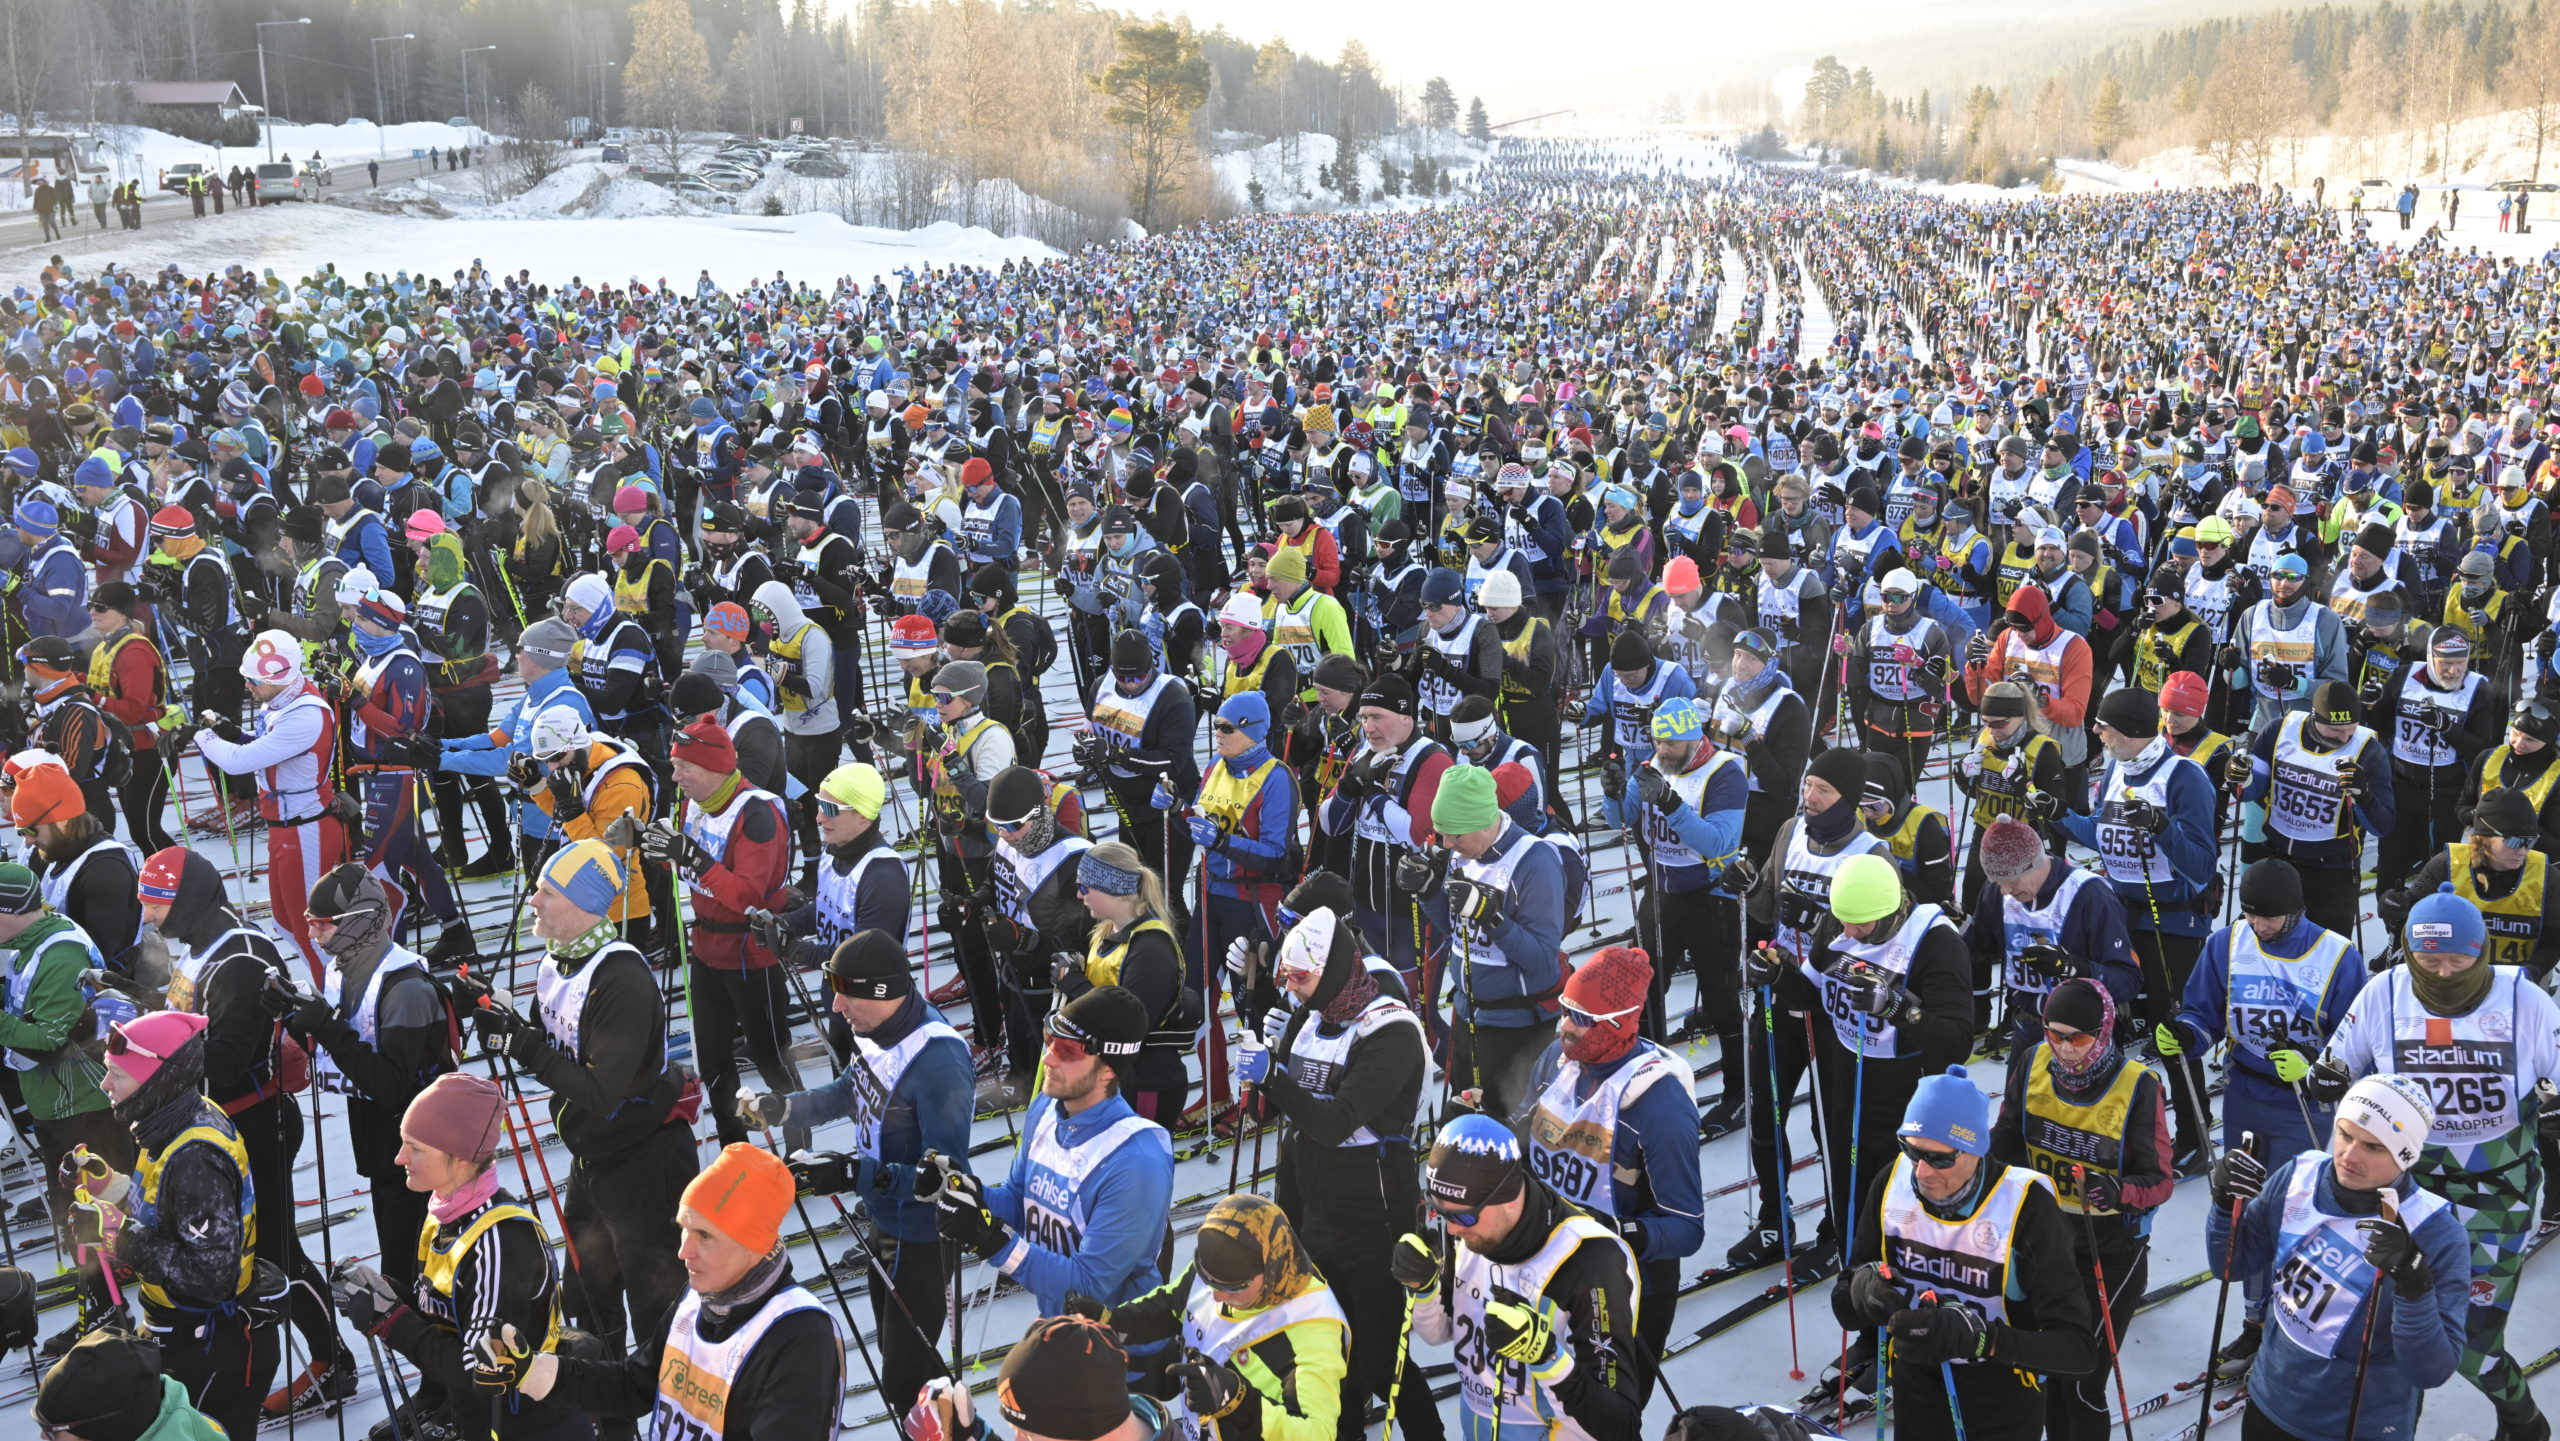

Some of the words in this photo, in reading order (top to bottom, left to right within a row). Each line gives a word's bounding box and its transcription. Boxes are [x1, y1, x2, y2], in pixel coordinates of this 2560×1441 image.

[2278, 647, 2308, 657] preem
[2330, 711, 2351, 721] XXL
[2277, 766, 2338, 790] stadium
[2274, 784, 2336, 825] 13653
[2414, 929, 2451, 938] Sportslager
[2404, 1045, 2503, 1068] stadium
[2347, 1095, 2392, 1124] ATTENFALL
[2040, 1120, 2103, 1163] IBM
[1532, 1146, 1599, 1201] 9687
[1895, 1246, 1990, 1290] stadium
